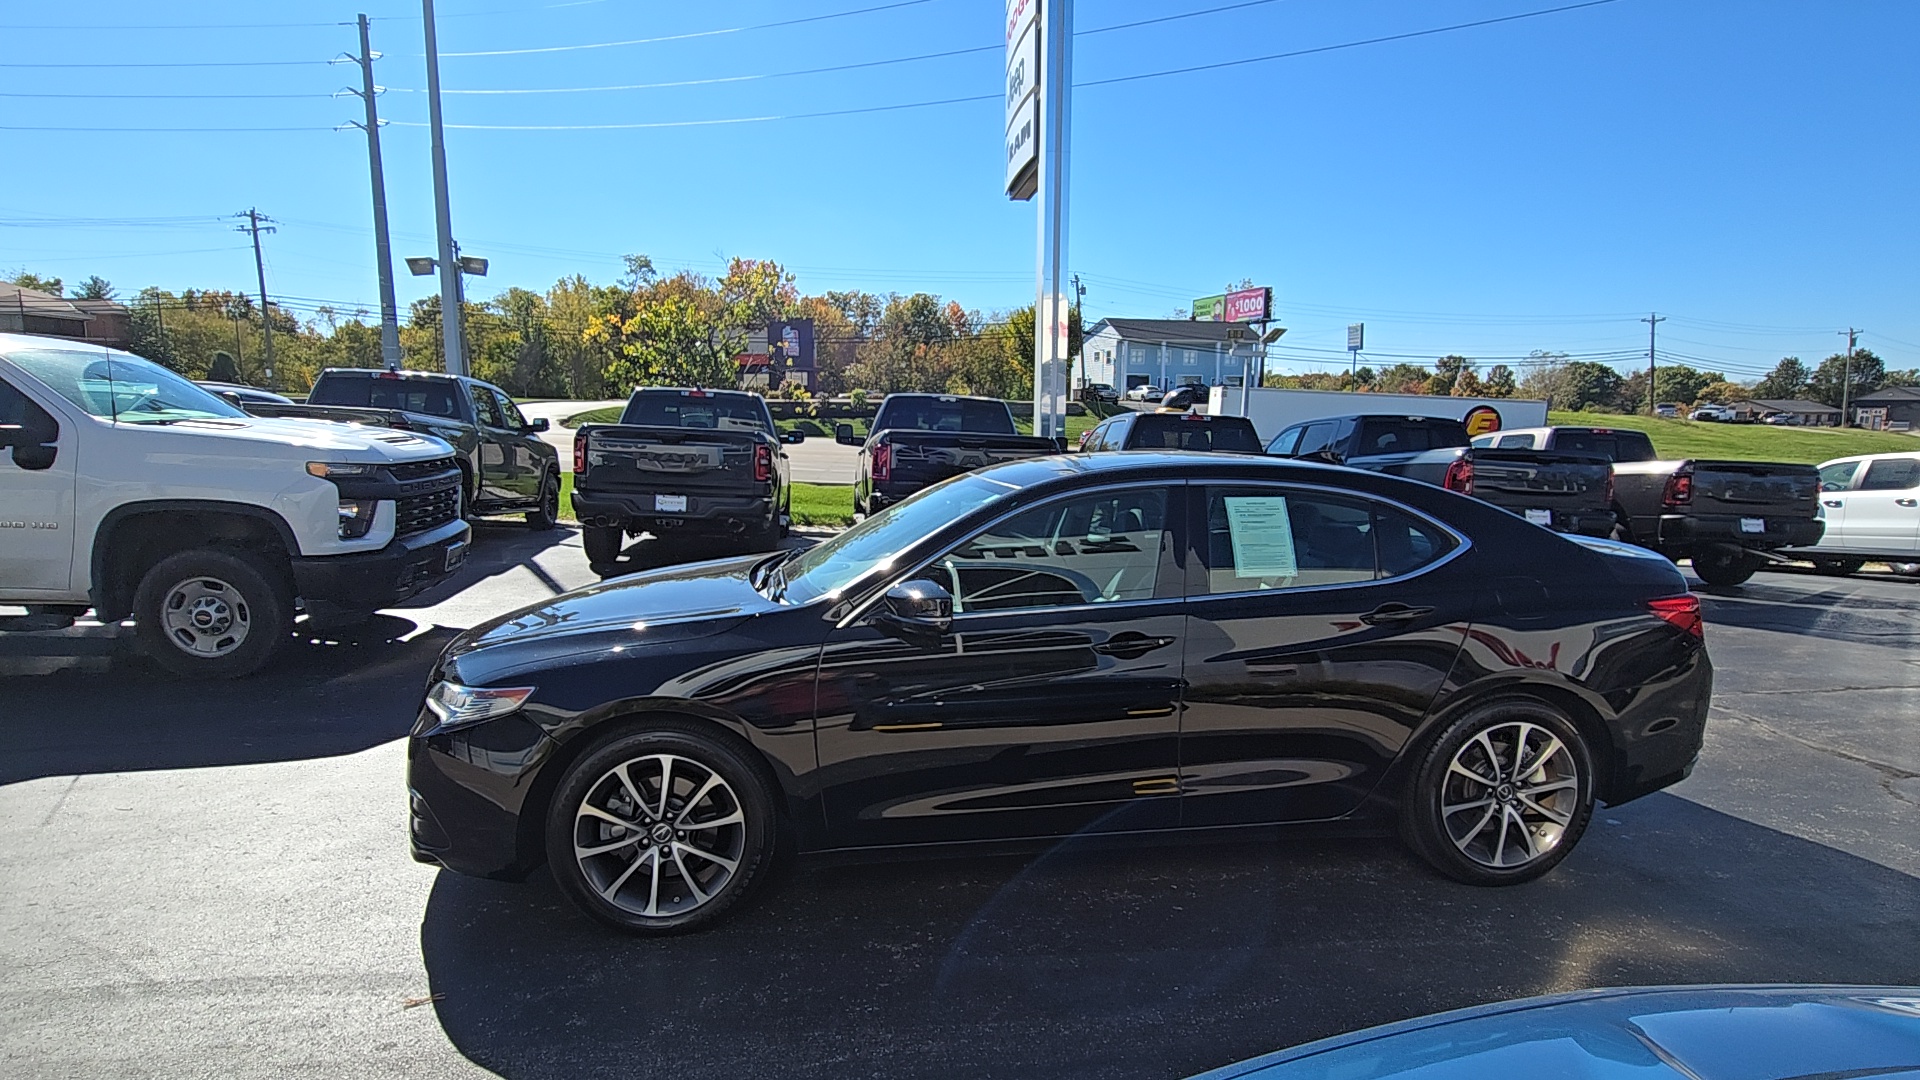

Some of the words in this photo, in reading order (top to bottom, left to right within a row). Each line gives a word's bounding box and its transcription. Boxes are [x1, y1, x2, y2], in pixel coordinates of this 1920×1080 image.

[1009, 119, 1031, 163] RAM
[1235, 297, 1263, 313] $1000
[632, 451, 709, 465] RAM
